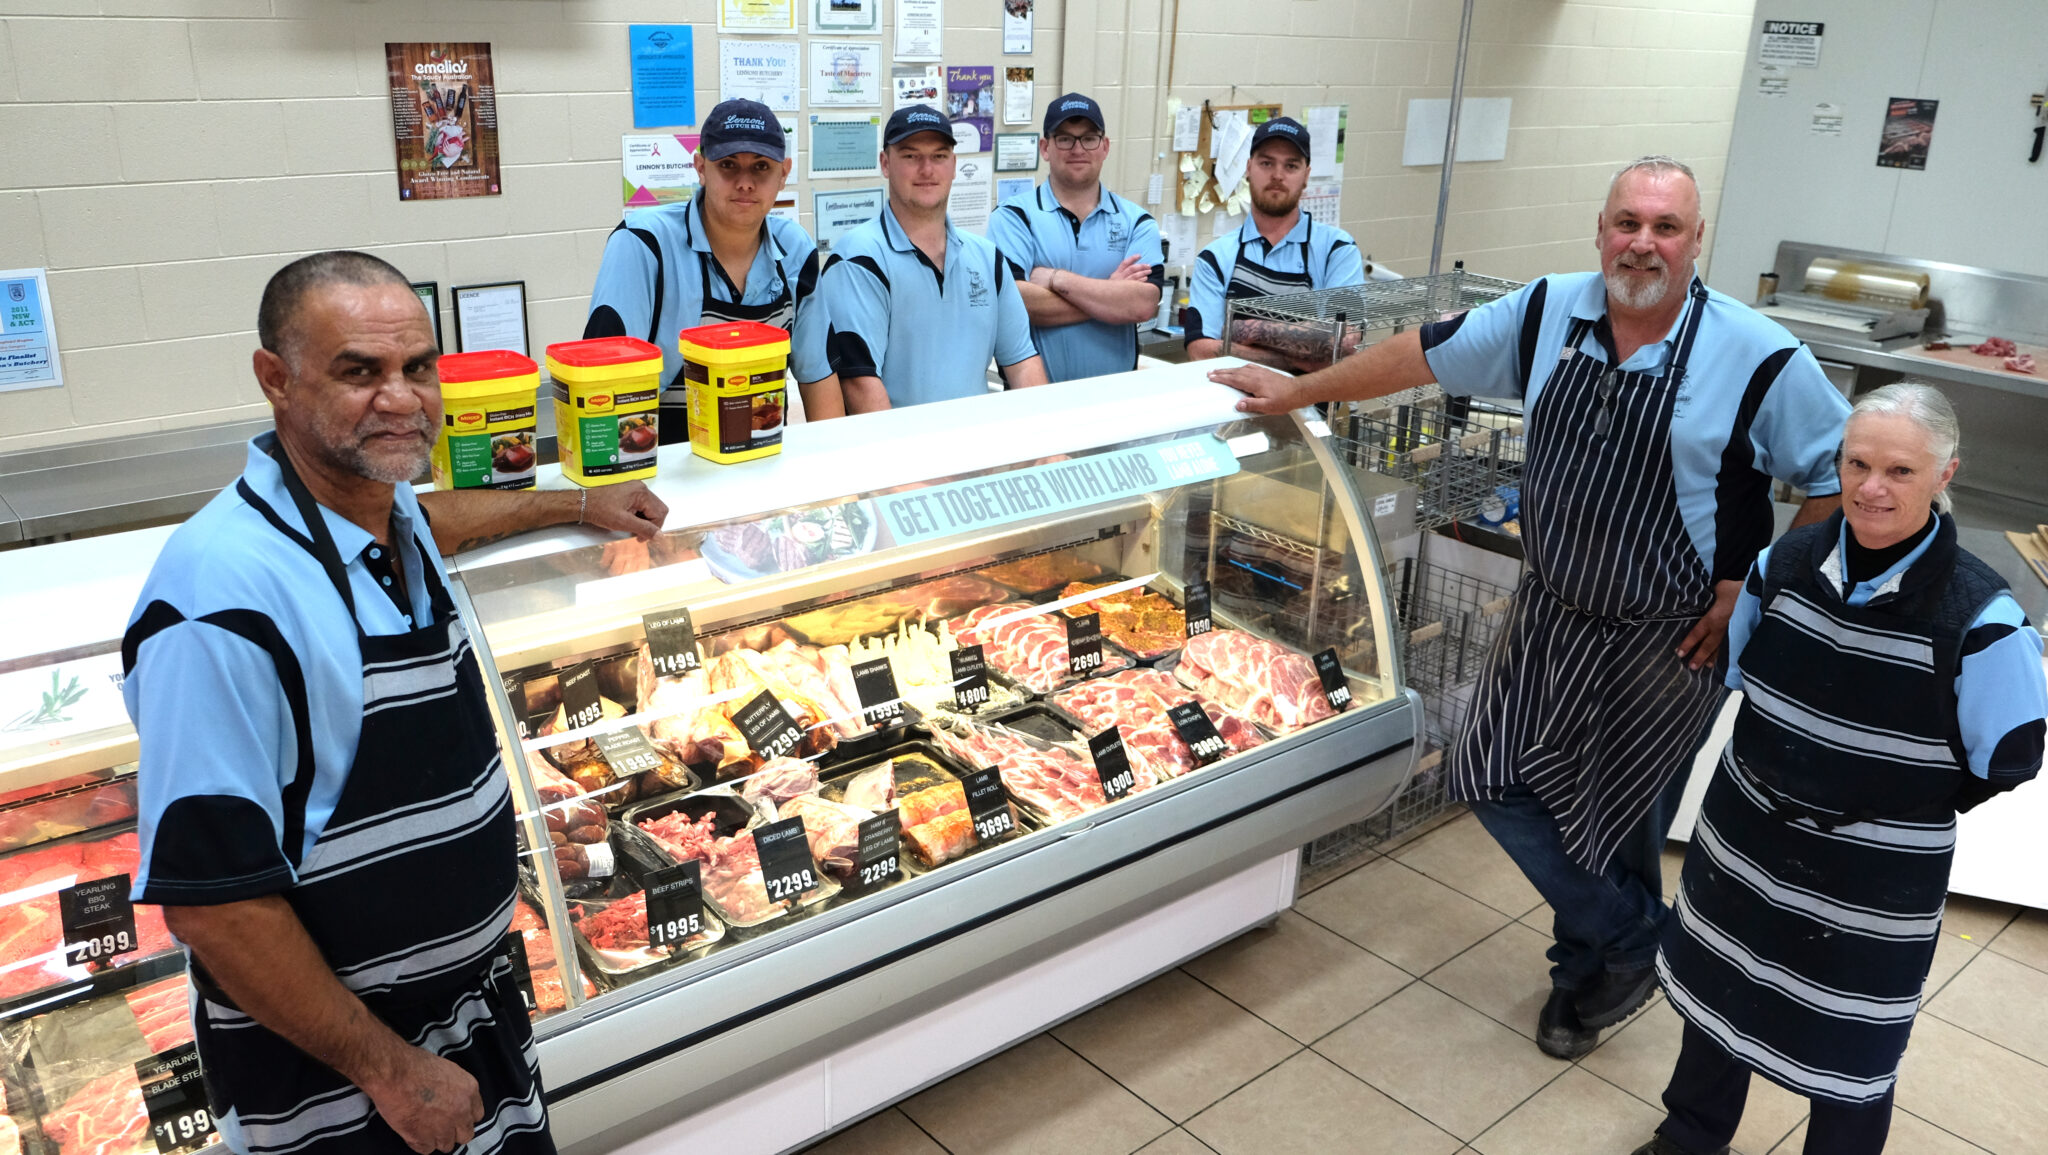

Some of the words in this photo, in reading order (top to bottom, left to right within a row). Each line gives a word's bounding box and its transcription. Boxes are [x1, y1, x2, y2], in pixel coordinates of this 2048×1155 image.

[1769, 23, 1818, 35] NOTICE
[415, 59, 468, 74] emelia's
[733, 58, 764, 66] THANK
[766, 56, 786, 67] YOU!
[950, 68, 978, 82] Thank
[978, 75, 992, 86] you
[724, 114, 765, 125] Lennon's
[889, 493, 940, 537] GET
[932, 466, 1052, 529] TOGETHER
[1041, 461, 1106, 504] WITH
[1098, 452, 1158, 493] LAMB
[566, 679, 576, 687] BEEF
[577, 669, 591, 682] ROAST
[744, 702, 771, 726] BUTTERFLY
[749, 725, 760, 735] LEG
[760, 719, 767, 727] OF
[766, 709, 780, 722] LAMB
[976, 774, 988, 783] LAMB
[972, 788, 986, 798] FILLET
[987, 784, 998, 792] ROLL
[870, 821, 881, 829] HAM
[763, 833, 781, 843] DICED
[781, 828, 798, 838] LAMB
[864, 826, 893, 842] CRANBERRY
[863, 845, 873, 854] LEG
[881, 836, 894, 846] LAMB
[75, 883, 116, 896] YEARLING
[652, 884, 669, 894] BEEF
[670, 878, 693, 889] STRIPS
[88, 895, 105, 904] BBQ
[84, 903, 111, 914] STEAK
[153, 1053, 198, 1073] YEARLING
[152, 1077, 182, 1094] BLADE
